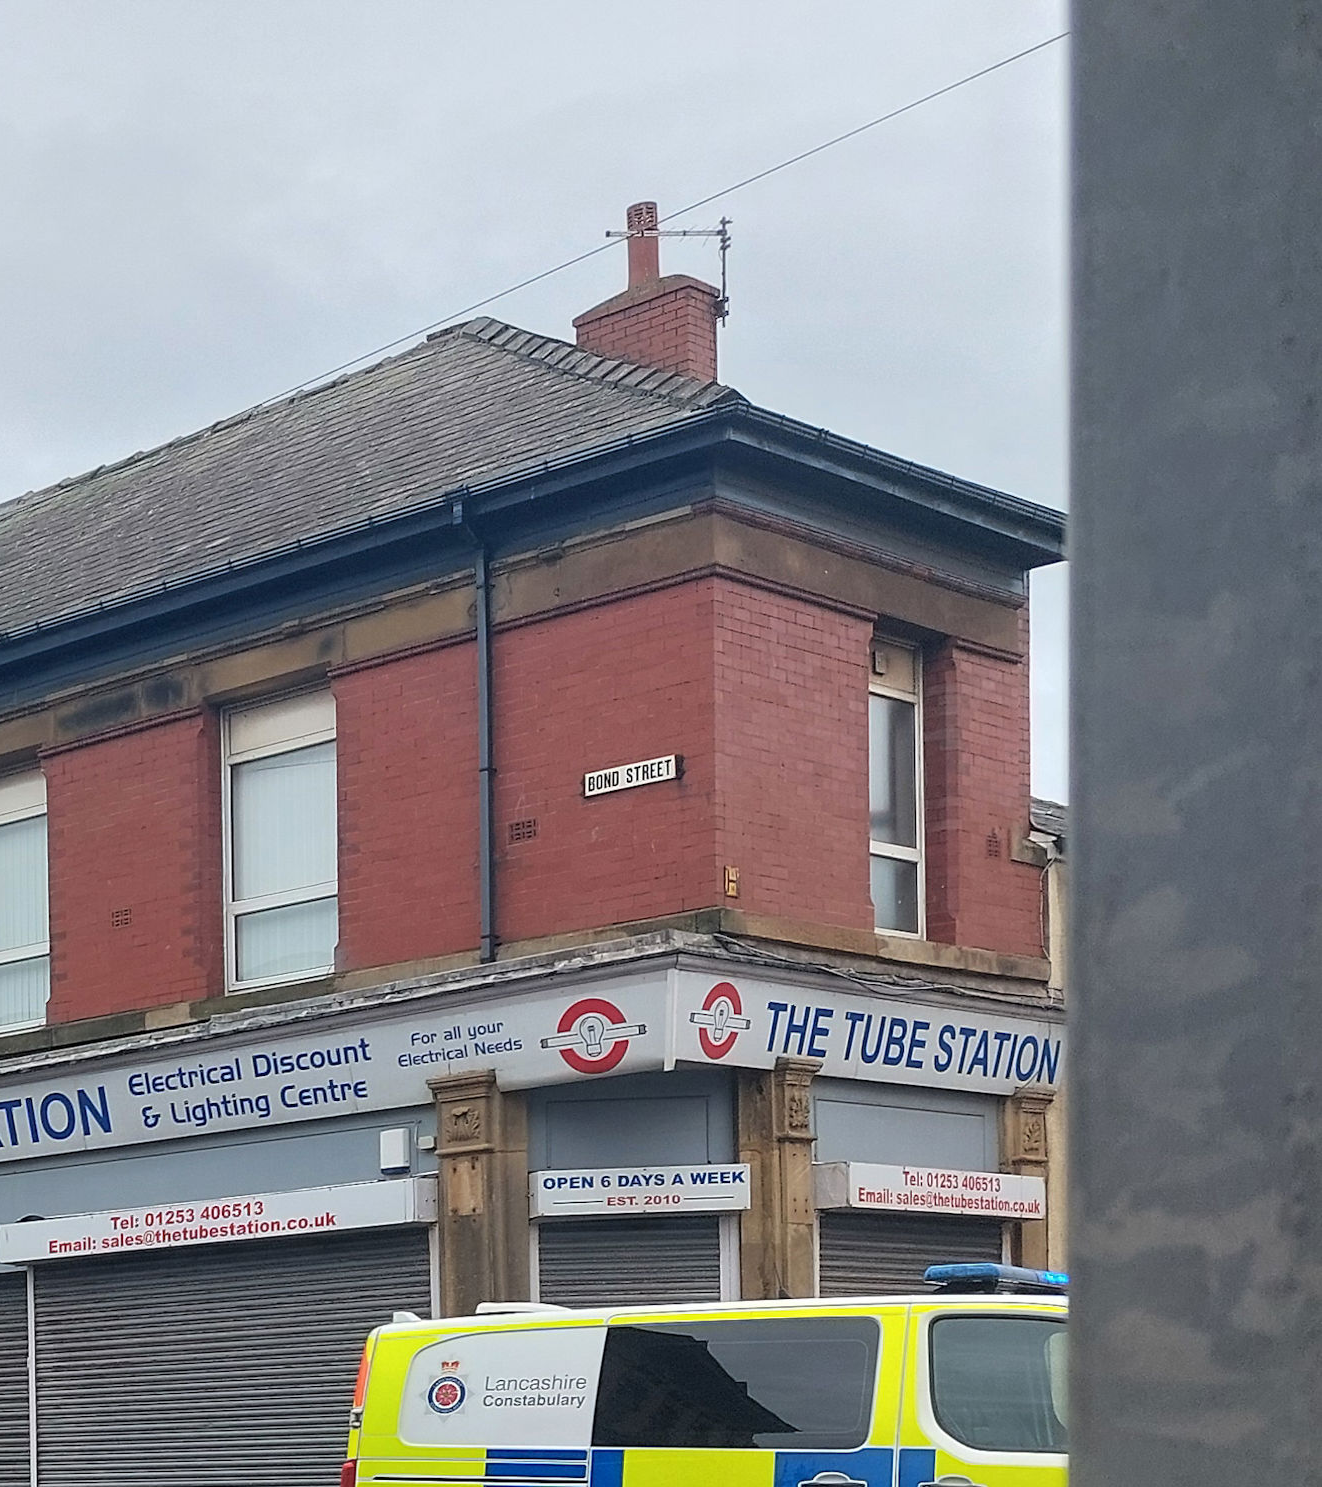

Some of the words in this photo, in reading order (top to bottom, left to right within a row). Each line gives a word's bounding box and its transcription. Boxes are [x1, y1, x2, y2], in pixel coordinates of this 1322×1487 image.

[588, 771, 620, 792] BOND
[626, 759, 672, 783] STREET
[409, 1031, 438, 1048] For
[443, 1025, 462, 1042] all
[468, 1021, 504, 1040] your
[767, 1001, 834, 1058] THE
[844, 1011, 931, 1069] TUBE
[933, 1024, 1061, 1085] STATION
[398, 1046, 469, 1068] Electrical
[474, 1036, 524, 1057] Needs
[128, 1057, 243, 1096] Electrical
[252, 1038, 373, 1078] Discount
[142, 1106, 161, 1128] &
[170, 1092, 272, 1127] Lighting
[280, 1078, 369, 1110] Centre
[543, 1176, 594, 1190] OPEN
[600, 1175, 612, 1188] 6
[617, 1173, 665, 1187] DAYS
[671, 1173, 685, 1186] A
[690, 1170, 746, 1185] WEEK
[902, 1171, 924, 1187] Tel:
[926, 1173, 959, 1189] 01253
[961, 1177, 1001, 1193] 406513
[607, 1196, 639, 1207] EST.
[644, 1194, 681, 1206] 2010
[858, 1187, 894, 1205] Email:
[896, 1190, 1041, 1215] sales@thetubestation.co.uk
[110, 1215, 139, 1231] Tel:
[145, 1208, 195, 1227] 01253
[200, 1201, 264, 1221] 406513
[48, 1238, 97, 1254] Email:
[101, 1212, 336, 1250] sales@thetubestation.co.uk
[485, 1374, 587, 1392] Lancashire
[482, 1394, 586, 1409] Constabulary
